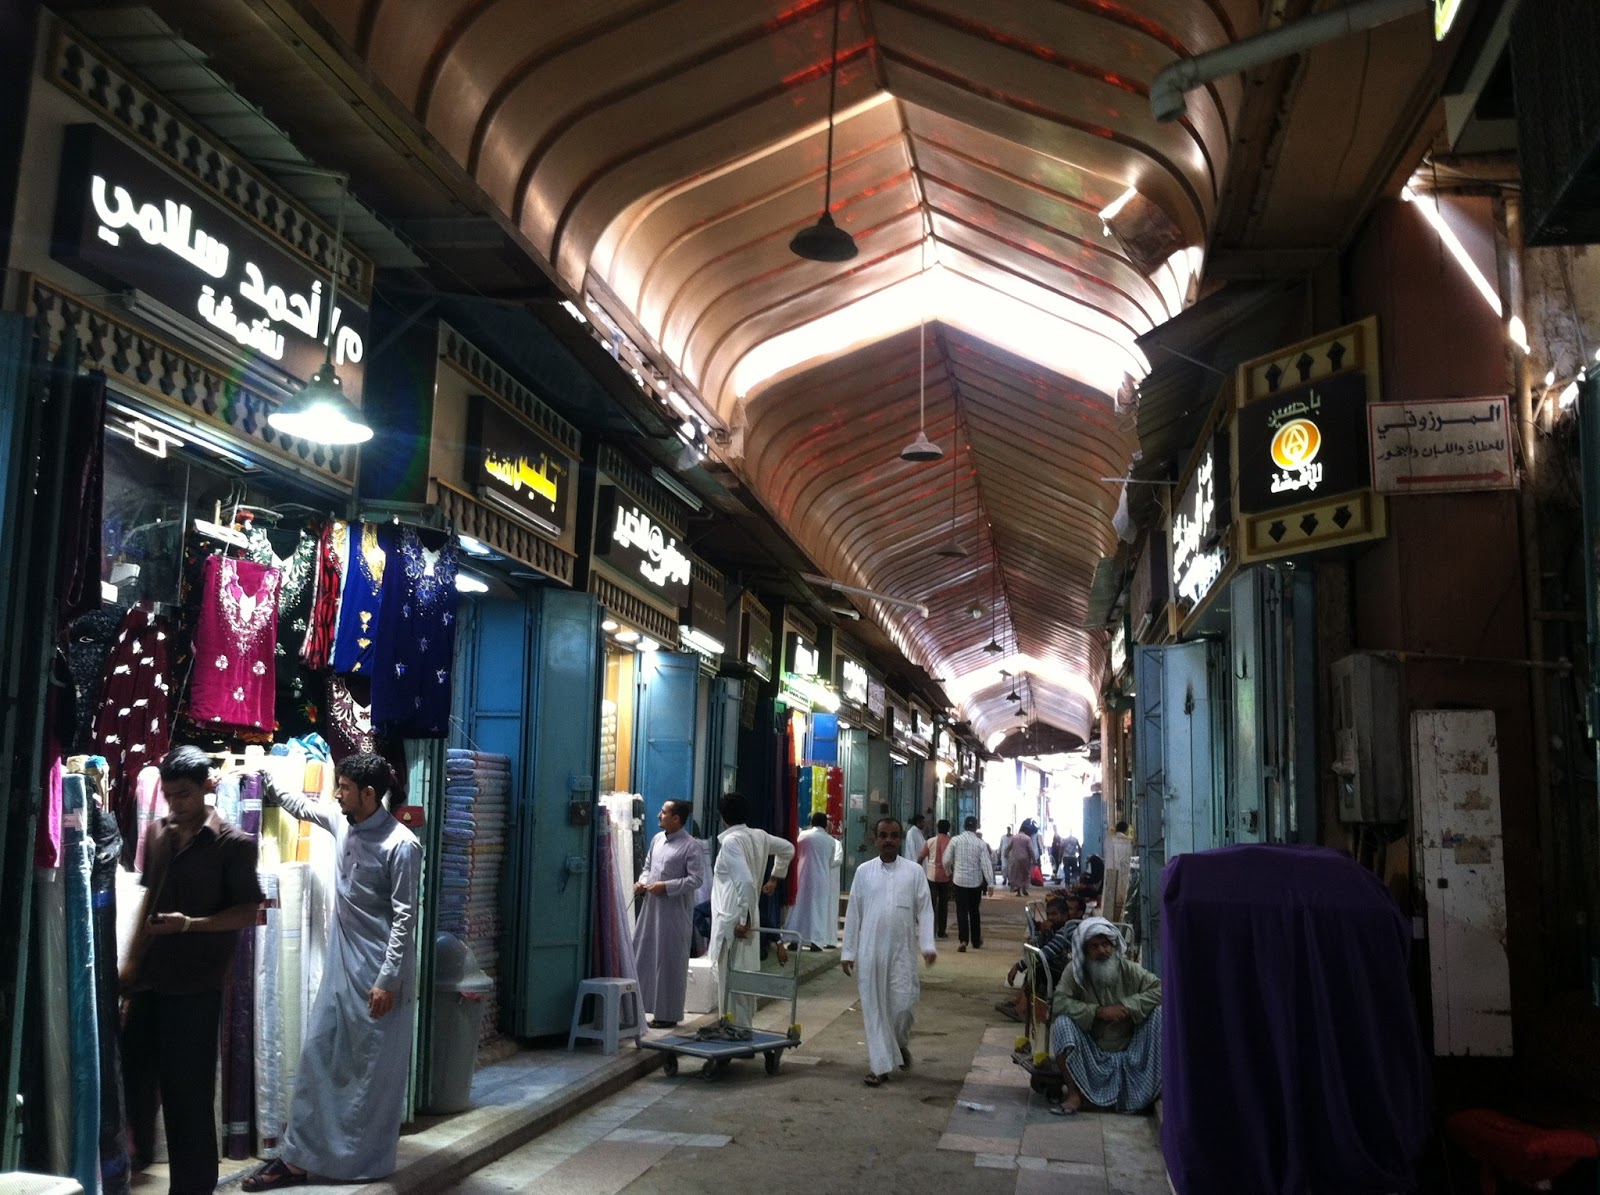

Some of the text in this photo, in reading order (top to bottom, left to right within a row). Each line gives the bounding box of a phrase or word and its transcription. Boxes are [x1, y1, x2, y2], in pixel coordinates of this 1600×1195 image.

[92, 175, 230, 278] سلامي
[240, 262, 322, 338] أحمد
[1375, 403, 1501, 440] المرزوقي
